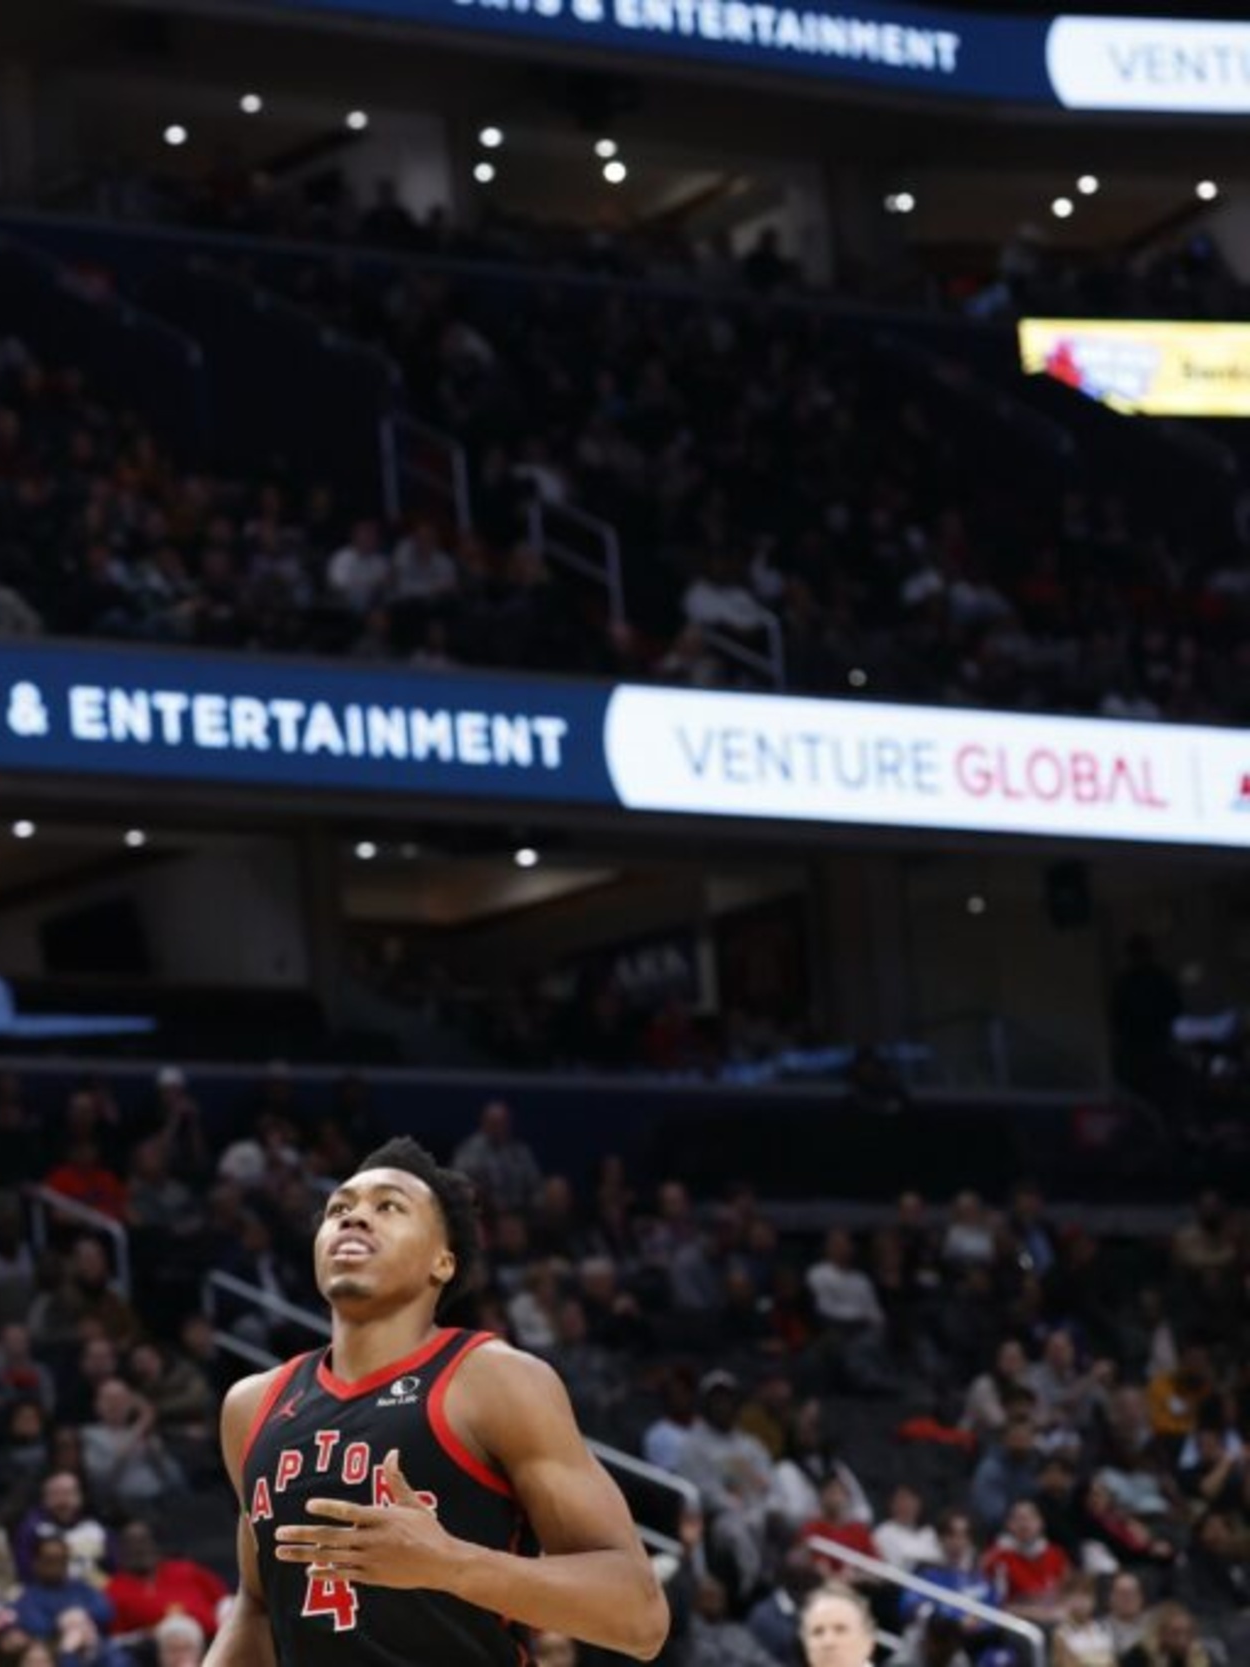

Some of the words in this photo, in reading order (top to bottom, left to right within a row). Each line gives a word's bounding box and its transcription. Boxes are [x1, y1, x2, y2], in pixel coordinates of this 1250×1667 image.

[614, 0, 959, 73] ENTERTAINMENT
[1105, 42, 1250, 84] VENT
[7, 681, 49, 736] &
[68, 685, 568, 769] ENTERTAINMENT
[674, 724, 940, 795] VENTURE
[953, 742, 1167, 810] GLOBAL
[302, 1559, 359, 1632] 4
